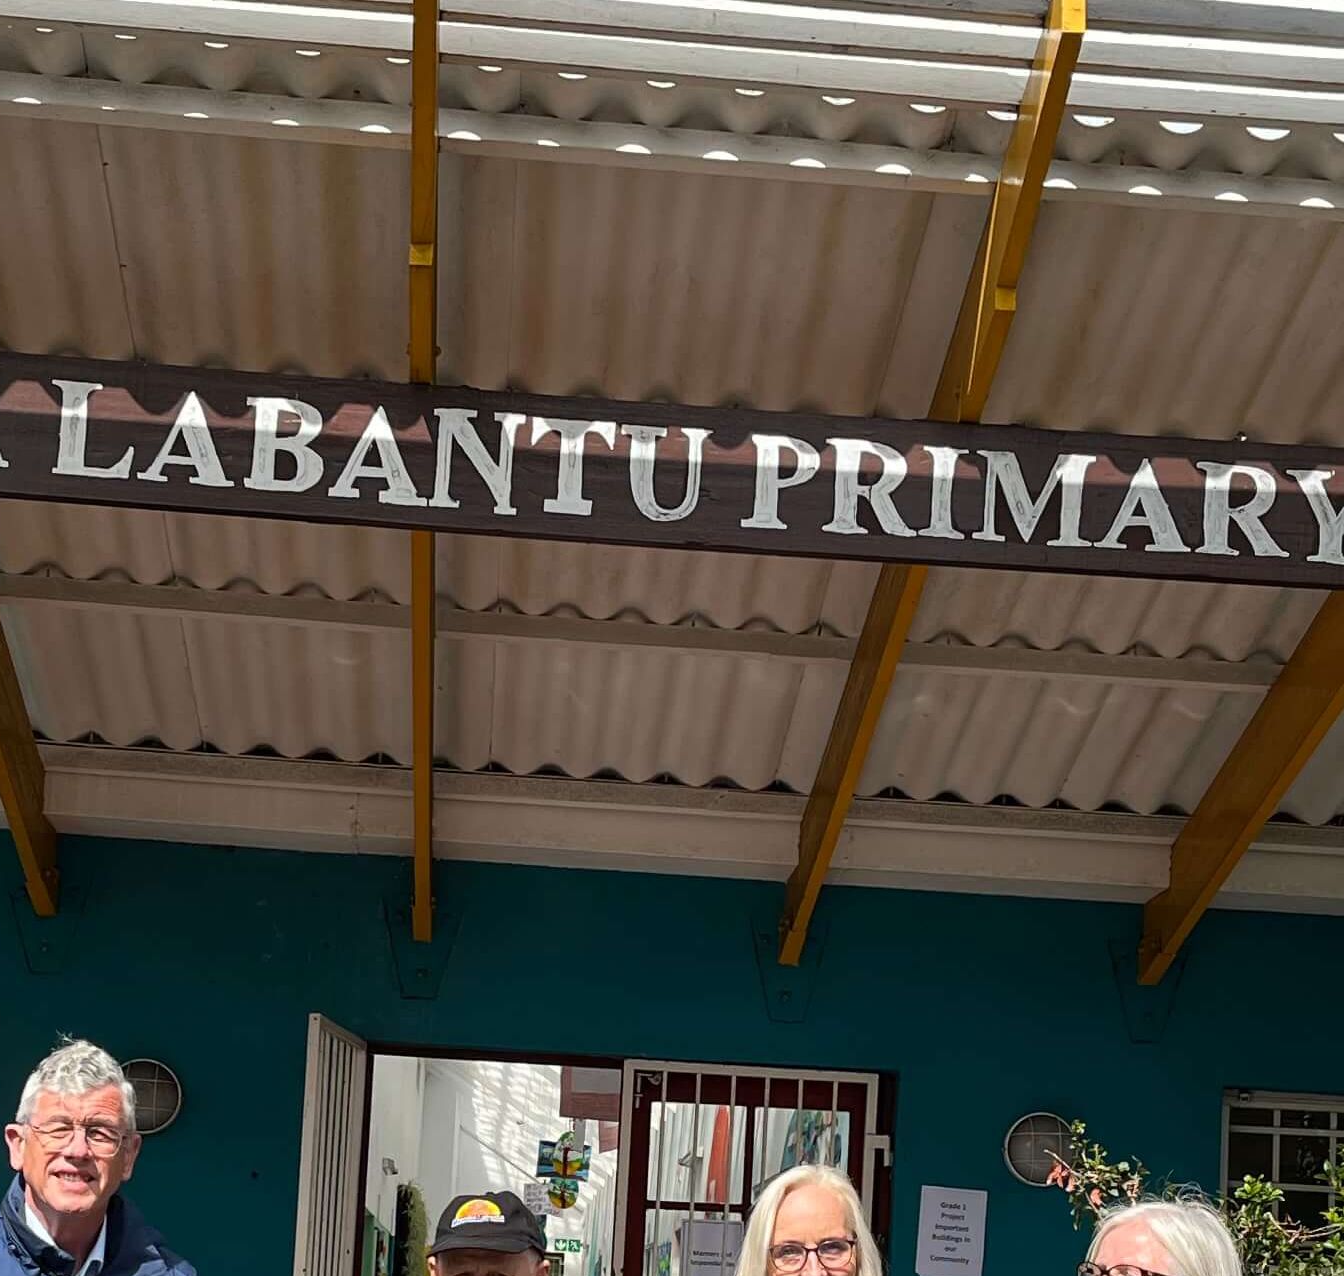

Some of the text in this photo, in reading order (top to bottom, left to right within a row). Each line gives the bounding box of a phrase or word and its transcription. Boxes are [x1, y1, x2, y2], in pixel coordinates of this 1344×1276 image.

[52, 378, 714, 522] LABANTU
[940, 1202, 961, 1210] Grade
[930, 1255, 969, 1265] Community
